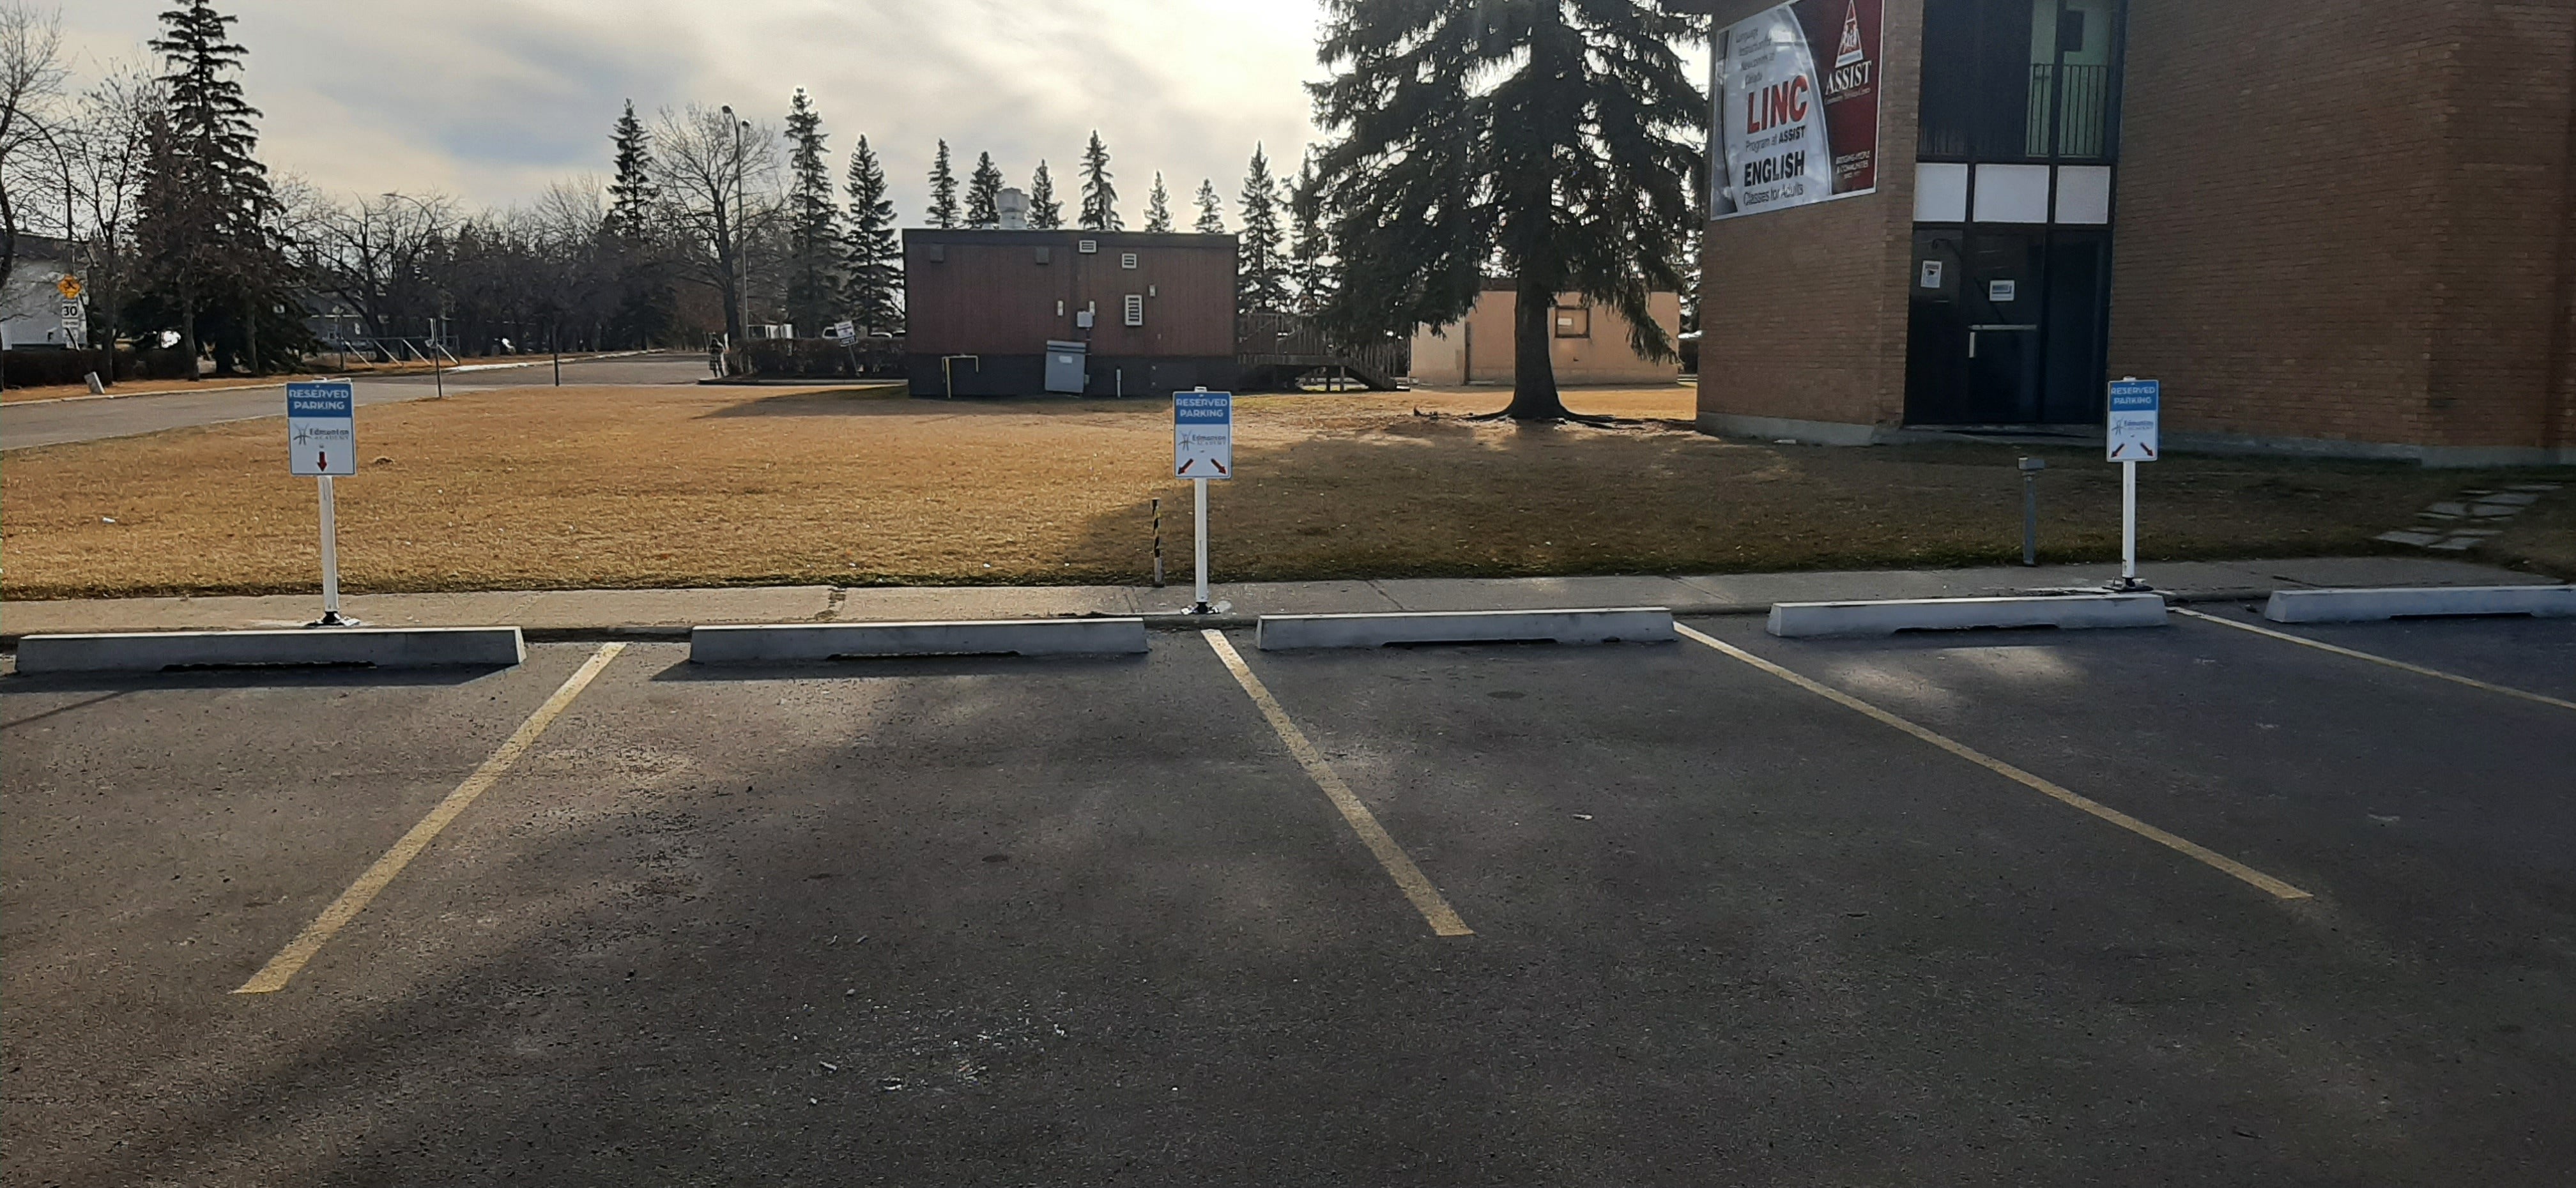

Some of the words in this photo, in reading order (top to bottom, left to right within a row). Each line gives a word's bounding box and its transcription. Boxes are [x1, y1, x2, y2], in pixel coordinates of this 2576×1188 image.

[1825, 60, 1872, 95] ASSIST
[1747, 75, 1809, 135] LINC
[1745, 137, 1770, 153] Program
[1772, 133, 1777, 146] at
[1779, 126, 1805, 144] ASSIST
[1744, 150, 1805, 187] ENGLISH
[1744, 190, 1770, 206] Classes
[1781, 181, 1804, 198] Adults
[64, 306, 77, 316] 30
[289, 389, 349, 399] RESERVED
[2111, 386, 2156, 395] RESERVED
[294, 401, 345, 409] PARKING
[1176, 399, 1227, 407] RESERVED
